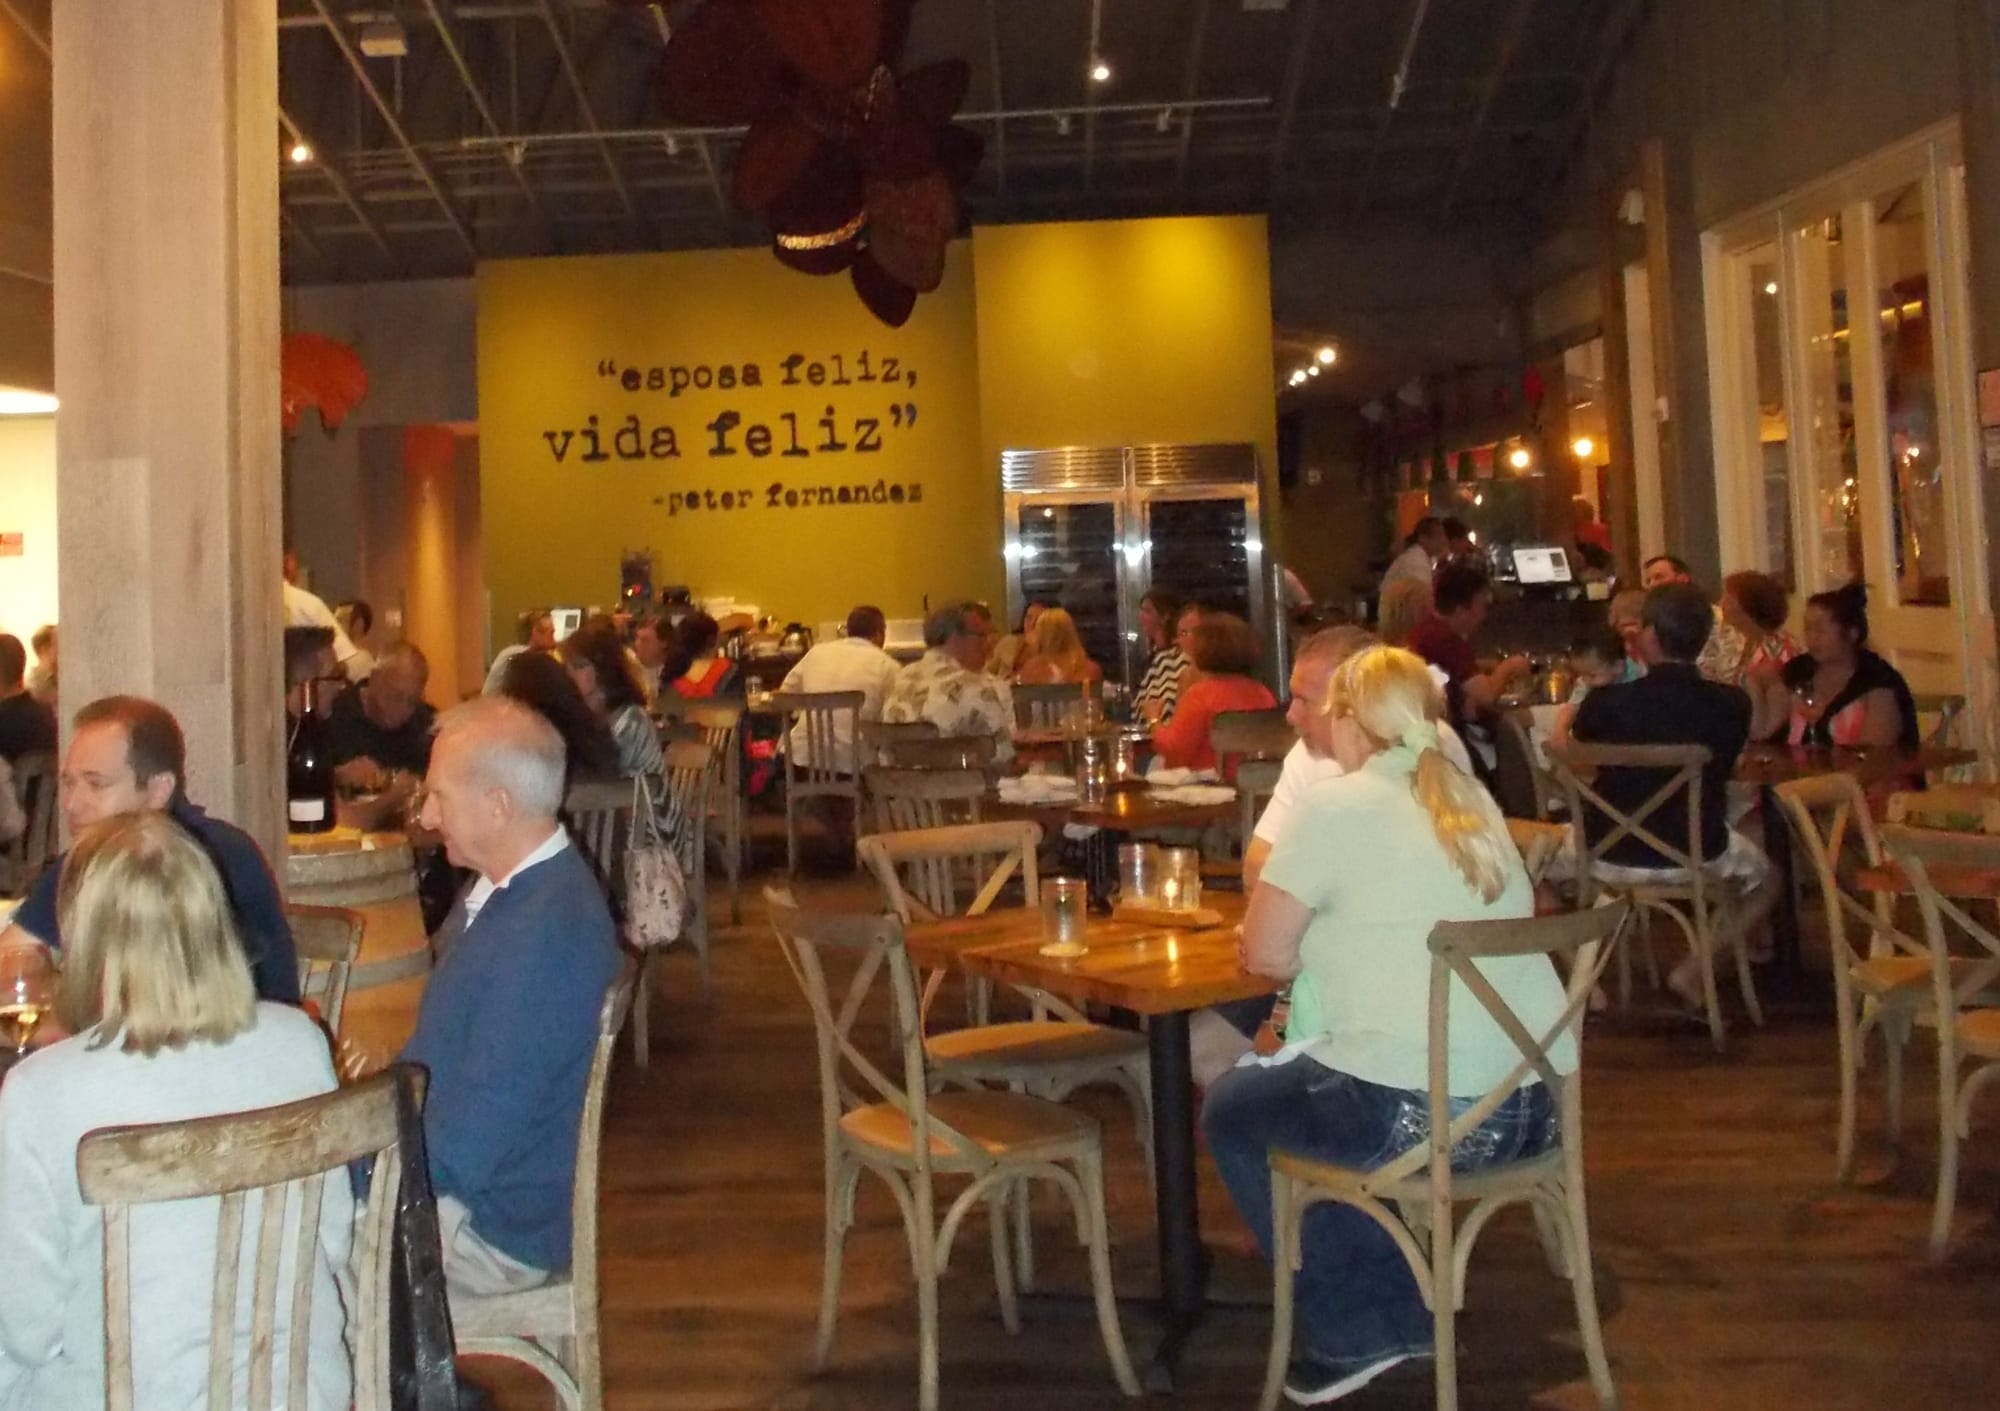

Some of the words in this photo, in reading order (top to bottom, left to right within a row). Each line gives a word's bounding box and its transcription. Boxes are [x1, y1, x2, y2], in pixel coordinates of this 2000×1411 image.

[597, 359, 763, 398] “esposa
[779, 350, 918, 388] feliz,
[542, 414, 681, 463] vida
[706, 402, 918, 459] feliz”
[653, 488, 753, 516] -peter
[765, 479, 923, 509] fernandez
